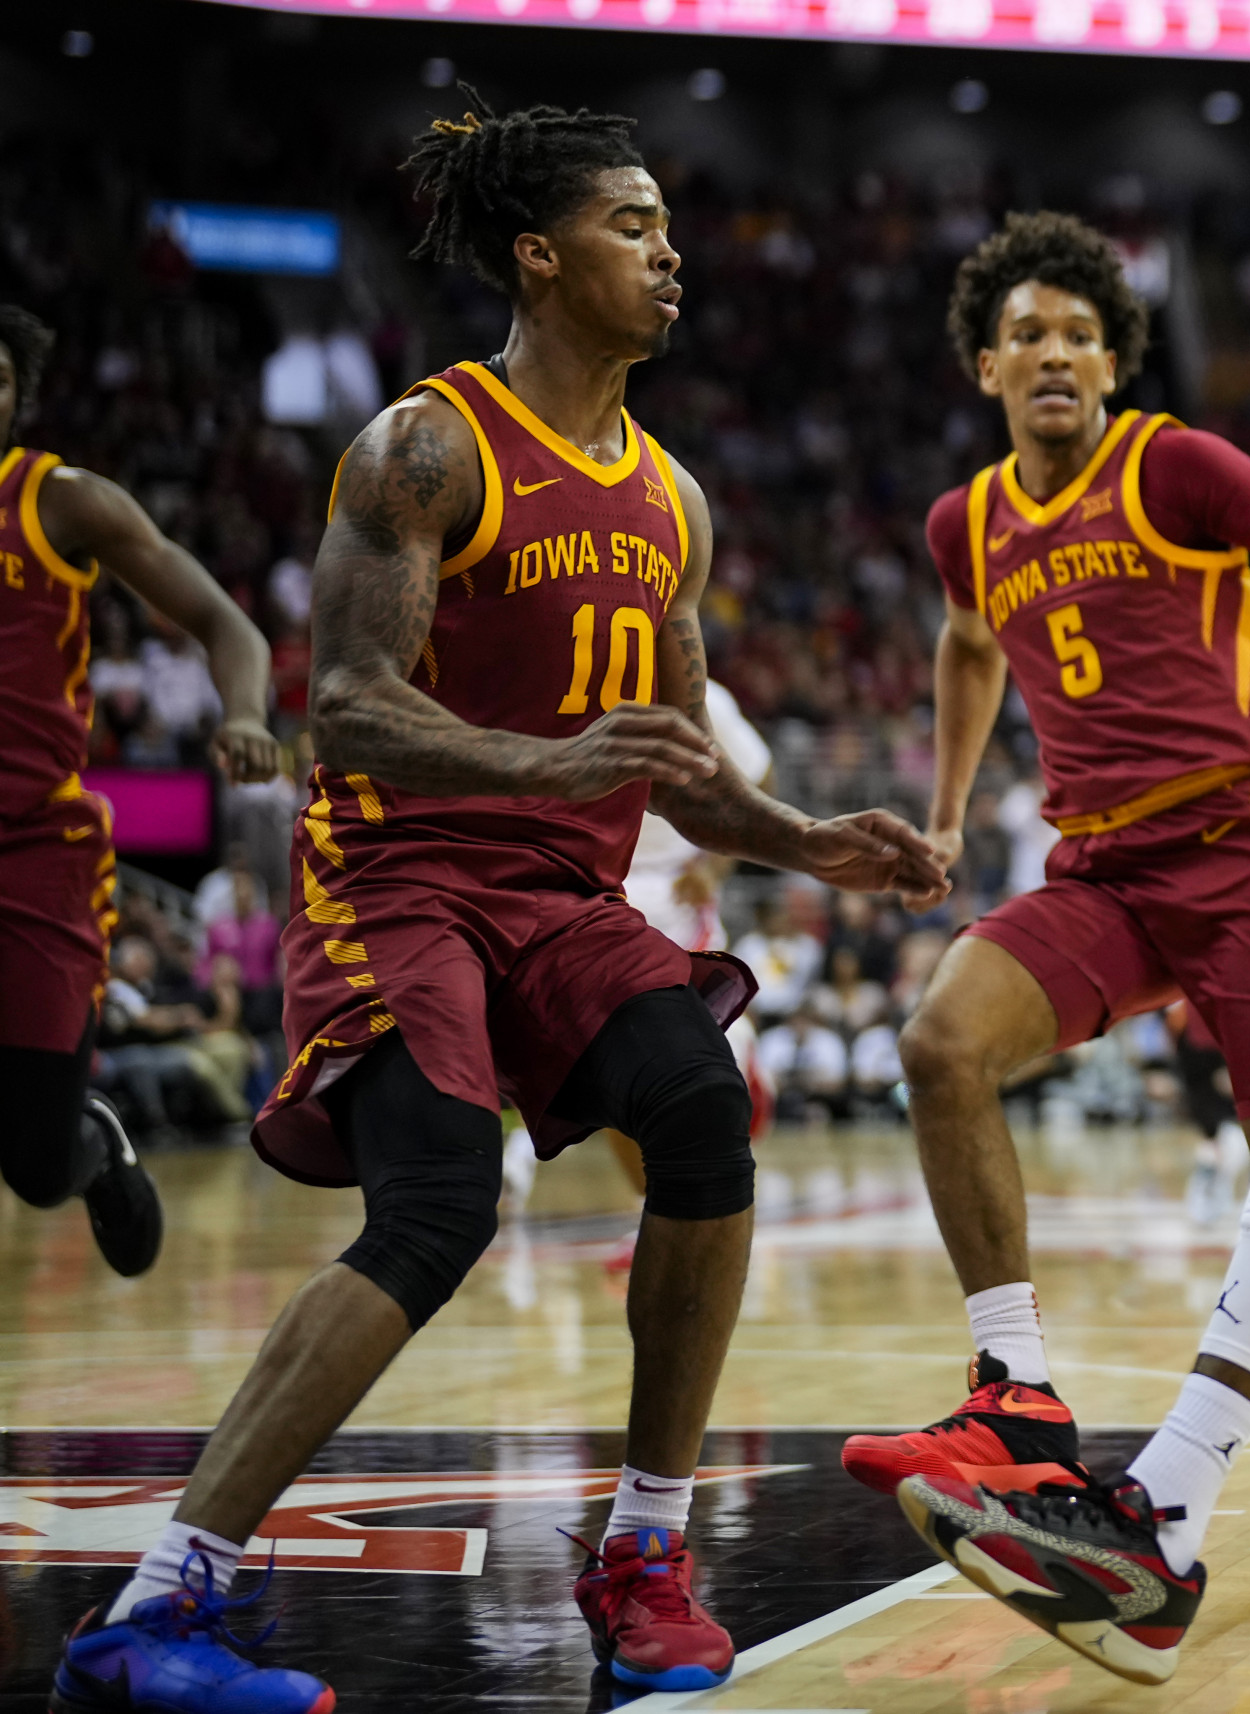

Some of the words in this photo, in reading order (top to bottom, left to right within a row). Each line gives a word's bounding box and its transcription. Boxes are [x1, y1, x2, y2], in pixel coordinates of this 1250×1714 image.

[504, 531, 599, 595] IOWA
[987, 559, 1048, 632] IOWA
[1048, 540, 1149, 587] STATE
[557, 604, 654, 714] 10
[1045, 602, 1103, 698] 5
